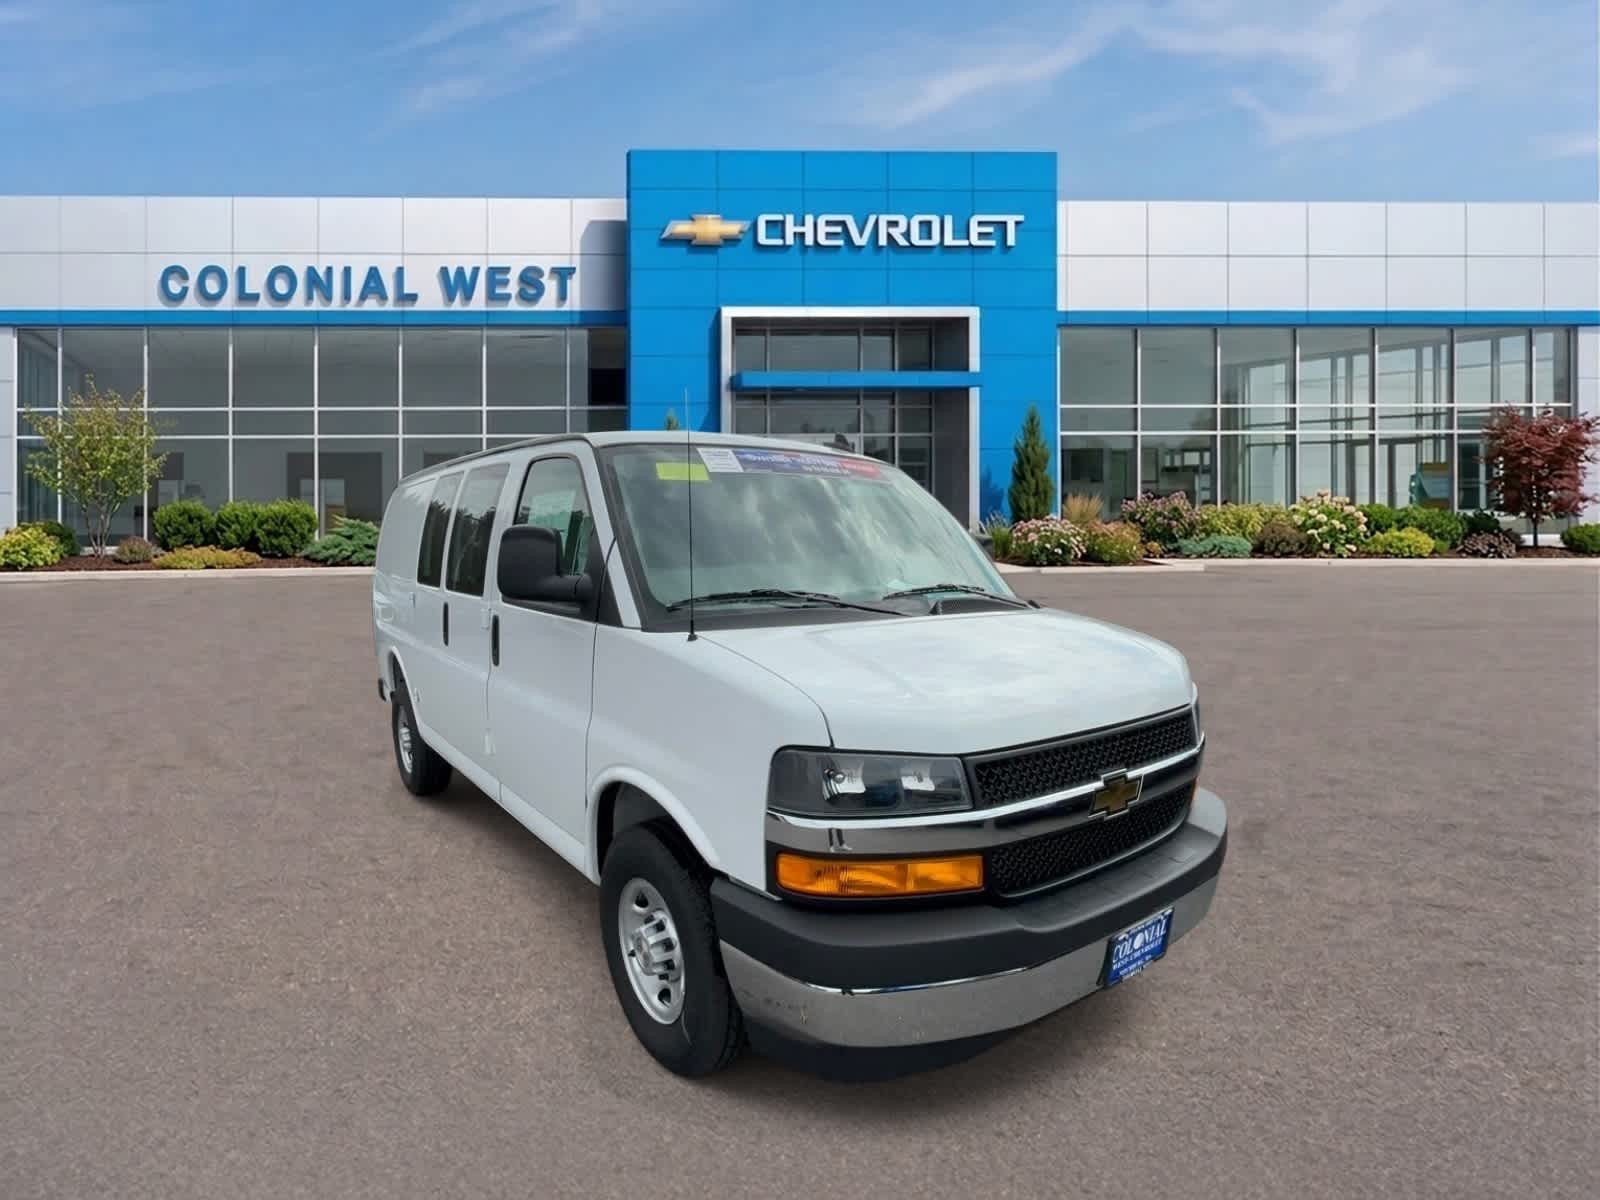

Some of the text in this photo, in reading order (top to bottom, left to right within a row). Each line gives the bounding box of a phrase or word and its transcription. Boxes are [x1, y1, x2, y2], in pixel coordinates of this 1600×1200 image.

[756, 213, 1025, 247] CHEVROLET
[160, 264, 577, 306] COLONIAL WEST
